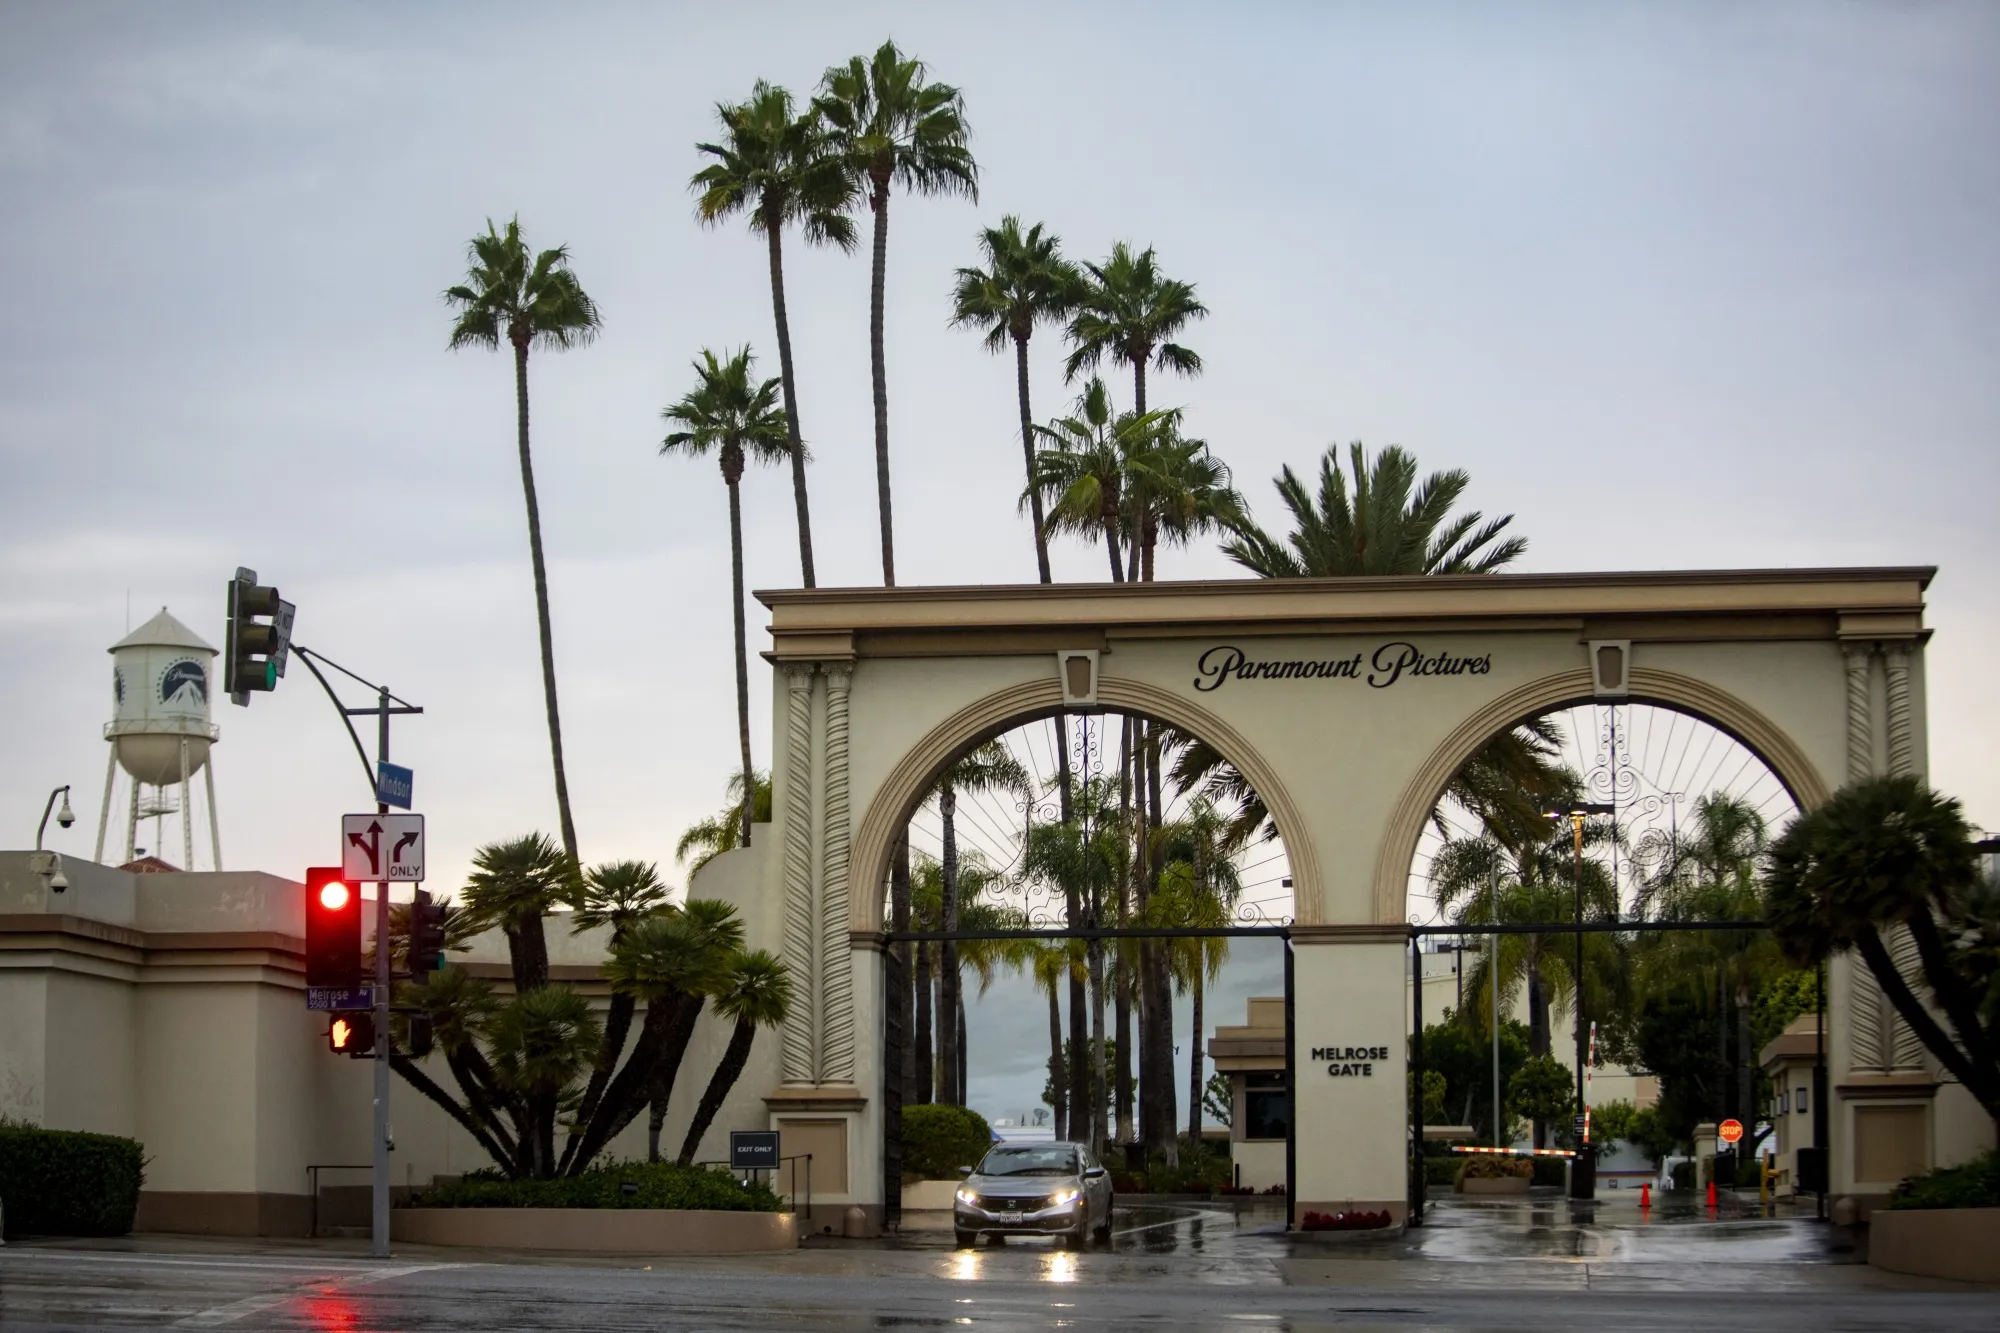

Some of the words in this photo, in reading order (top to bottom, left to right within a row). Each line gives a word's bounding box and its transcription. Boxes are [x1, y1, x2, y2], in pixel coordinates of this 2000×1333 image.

[1193, 645, 1363, 692] Paramount
[1367, 642, 1492, 689] Pictures
[379, 771, 410, 799] Windsor
[390, 866, 420, 877] ONLY
[309, 989, 349, 1000] Melrose
[309, 1000, 328, 1009] 5500
[1311, 1047, 1389, 1060] MELROSE
[1328, 1063, 1372, 1077] GATE
[1721, 1126, 1741, 1135] STOP
